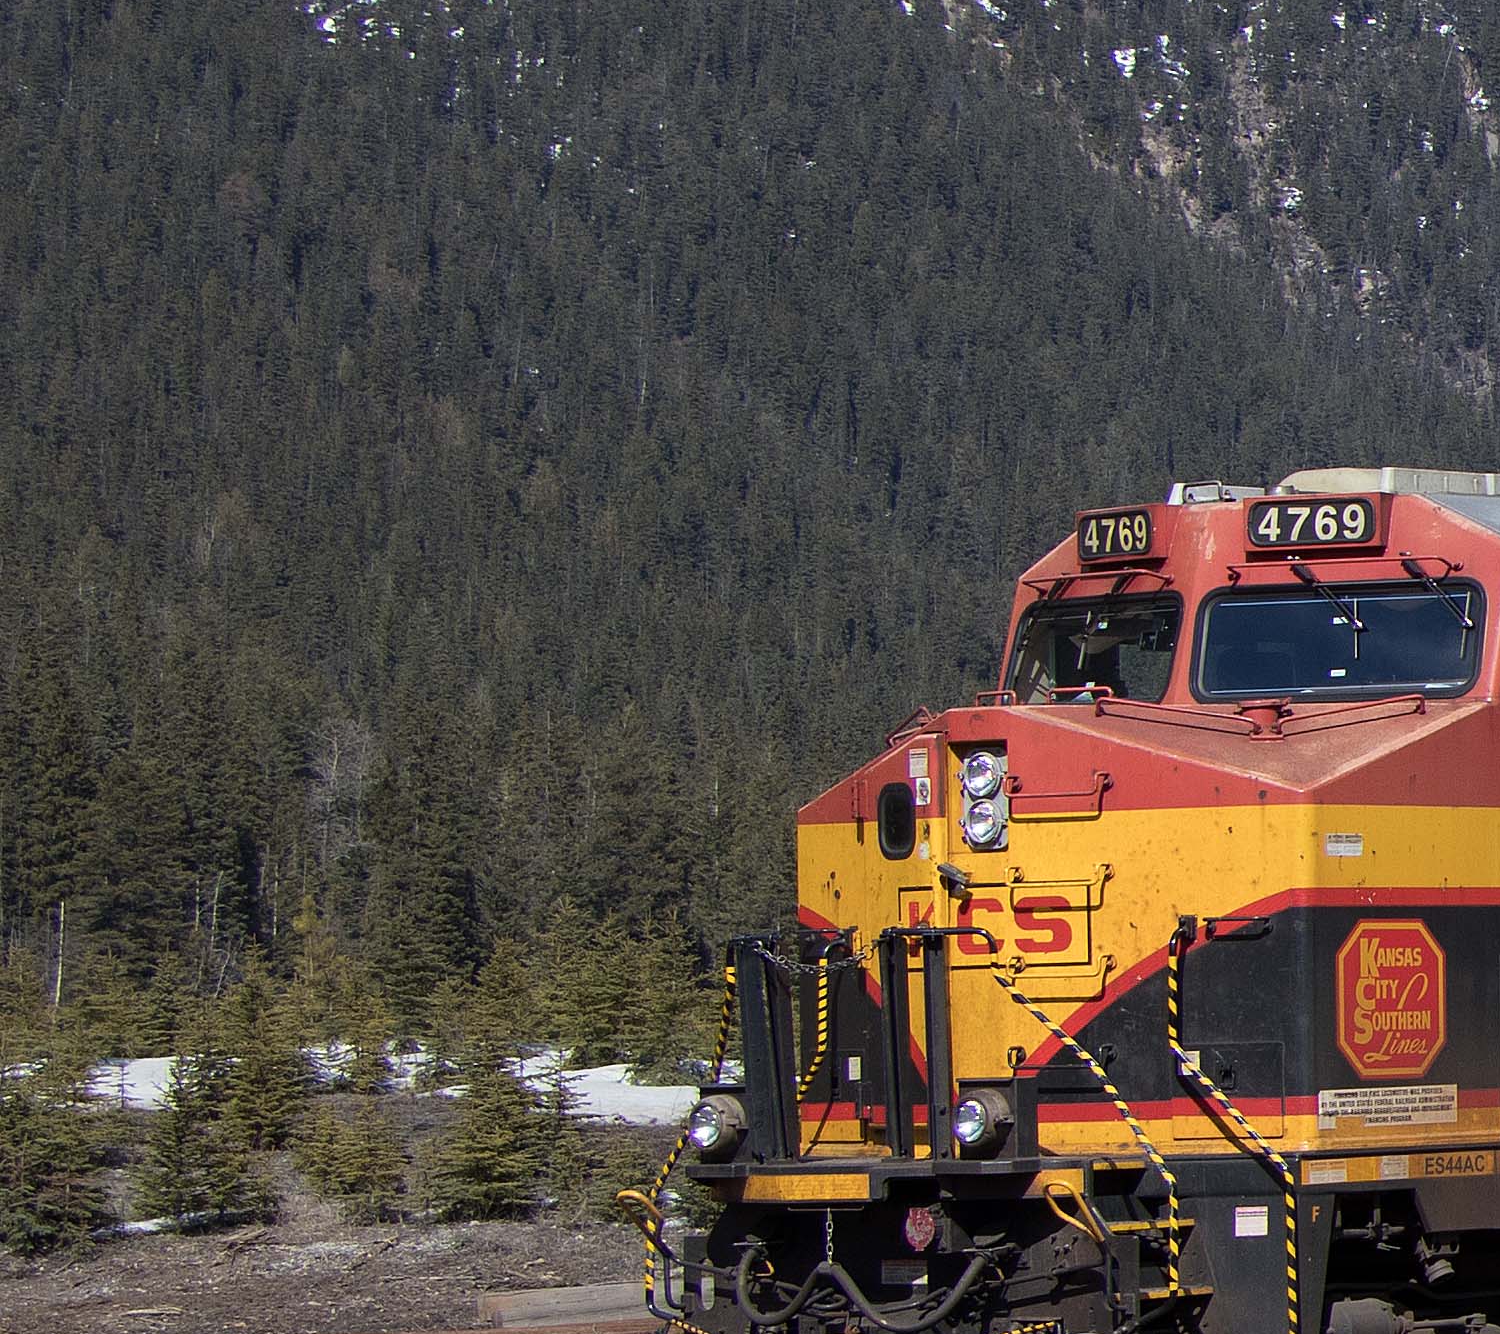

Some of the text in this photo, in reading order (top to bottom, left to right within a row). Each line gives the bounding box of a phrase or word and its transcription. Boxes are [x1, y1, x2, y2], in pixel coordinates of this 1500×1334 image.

[1084, 514, 1147, 553] 4769
[1258, 504, 1365, 541] 4769
[908, 895, 1073, 958] KCS
[1360, 938, 1422, 978] KANSAS
[1355, 977, 1399, 1010] CITY
[1354, 1007, 1432, 1044] SOUTHERN
[1363, 1031, 1428, 1063] Lines
[1424, 1154, 1486, 1175] ES44AC
[1311, 1205, 1321, 1223] F
